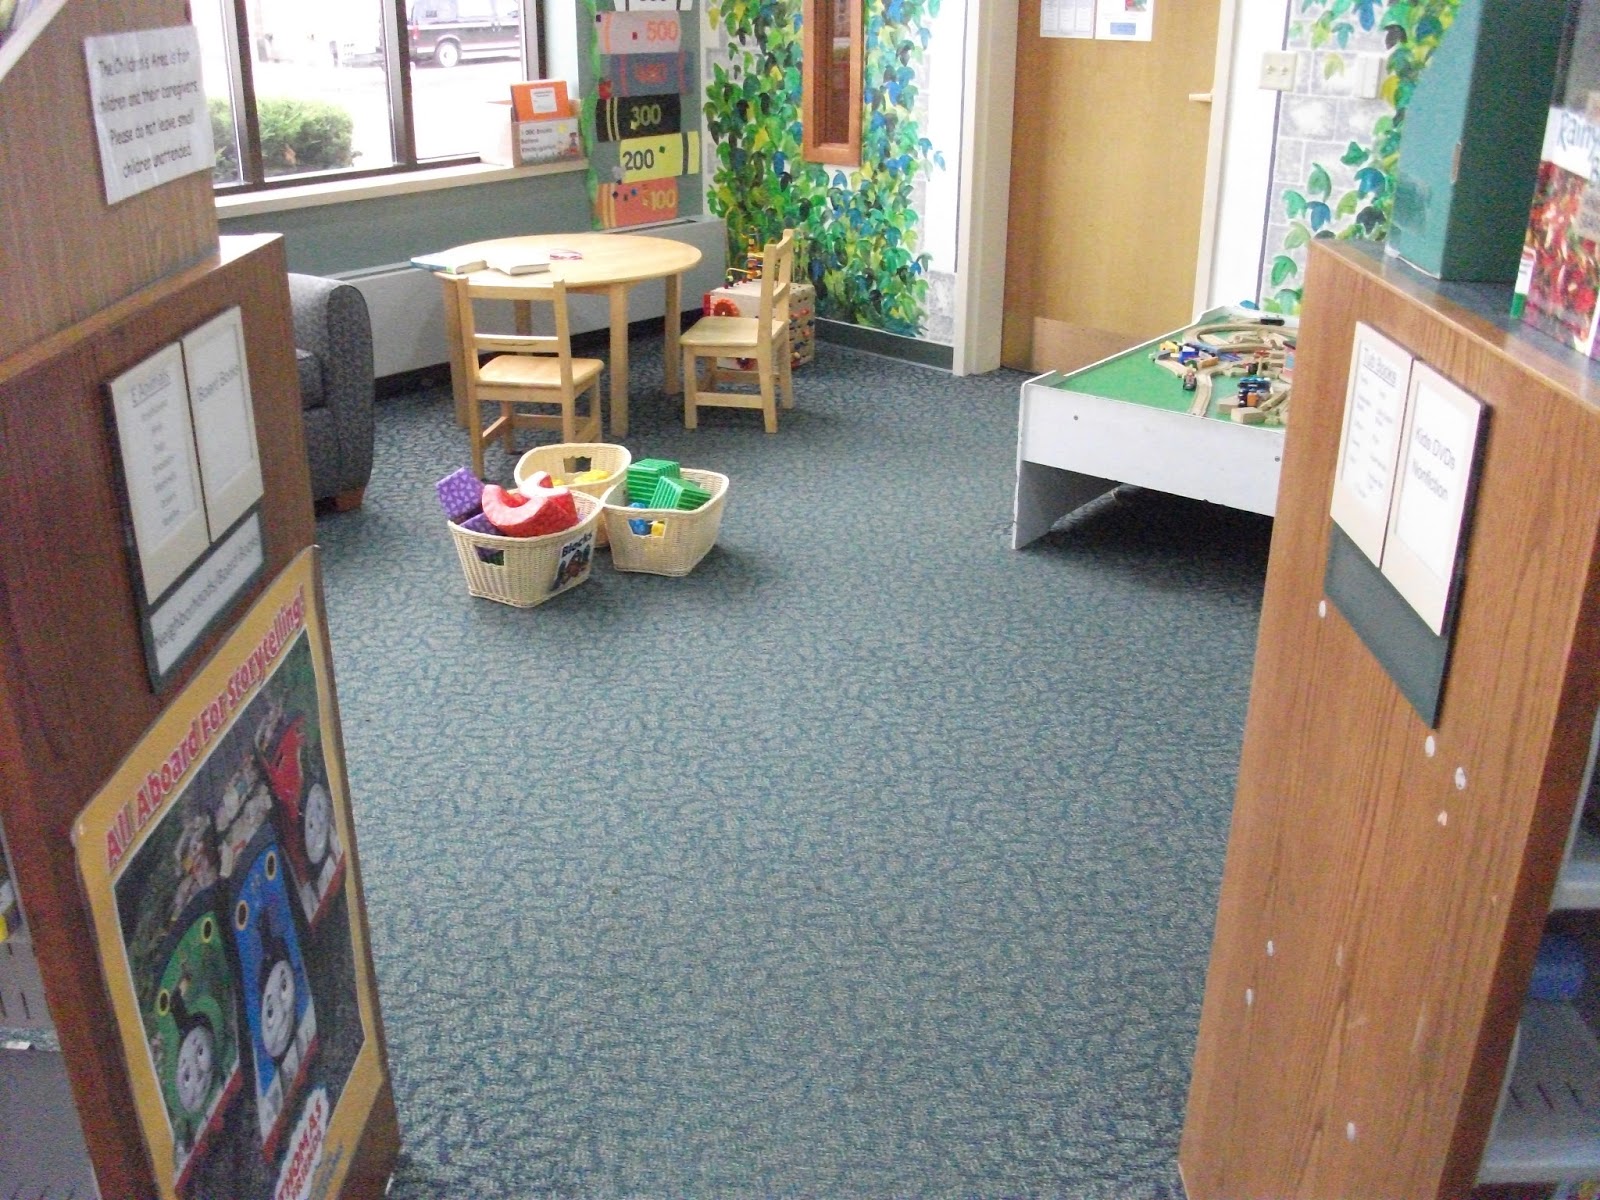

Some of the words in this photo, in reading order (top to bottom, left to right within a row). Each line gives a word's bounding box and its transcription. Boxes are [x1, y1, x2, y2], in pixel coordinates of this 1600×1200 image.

[646, 20, 678, 41] 500
[98, 59, 114, 76] The
[151, 52, 169, 67] Area
[177, 48, 190, 64] for
[99, 93, 126, 112] children
[128, 89, 142, 108] and
[141, 85, 160, 103] their
[110, 127, 133, 146] Please
[134, 125, 145, 139] do
[145, 121, 156, 136] not
[157, 116, 177, 132] leave
[177, 107, 195, 128] small
[630, 103, 662, 127] 300
[123, 155, 151, 178] children
[622, 148, 655, 171] 200
[1416, 427, 1432, 451] Kids
[1432, 439, 1456, 471] DVDs
[1412, 458, 1449, 501] Nonfiction
[562, 532, 593, 558] Blocks
[105, 803, 134, 870] All
[134, 720, 200, 834] Aboard
[199, 696, 230, 745] For
